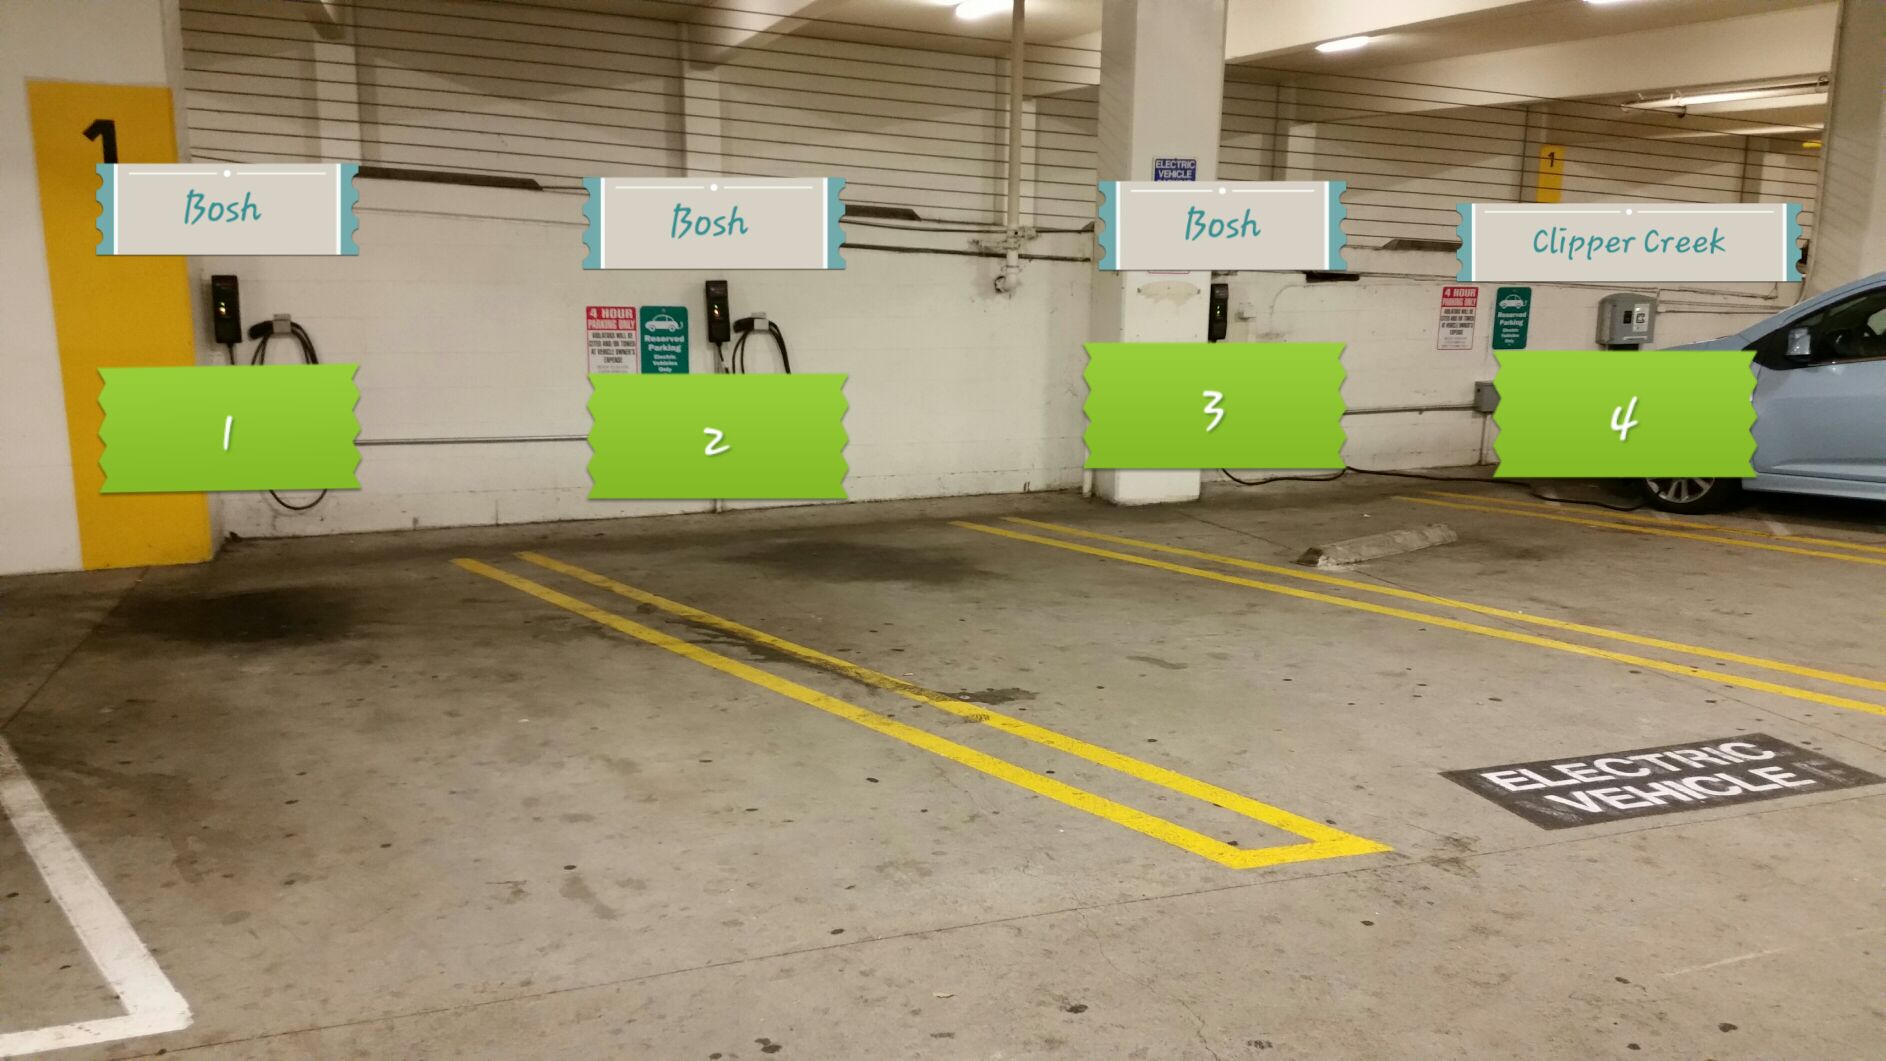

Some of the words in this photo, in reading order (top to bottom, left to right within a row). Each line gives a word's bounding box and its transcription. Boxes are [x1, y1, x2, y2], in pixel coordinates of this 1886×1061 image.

[82, 119, 118, 163] 1
[1547, 151, 1554, 167] 1
[1155, 160, 1196, 169] ELECTRIC
[1158, 169, 1193, 179] VEHICLE
[1444, 288, 1451, 297] 4
[1453, 288, 1476, 297] HOUR
[590, 308, 598, 319] 4
[601, 308, 633, 319] HOUR
[587, 319, 617, 329] PARKING
[618, 319, 635, 329] ONLY
[1499, 319, 1524, 327] Parking
[644, 335, 685, 343] Reserved
[648, 344, 682, 353] Parking
[1481, 742, 1777, 792] ELECTRIC
[1544, 766, 1816, 813] VEHICLE
